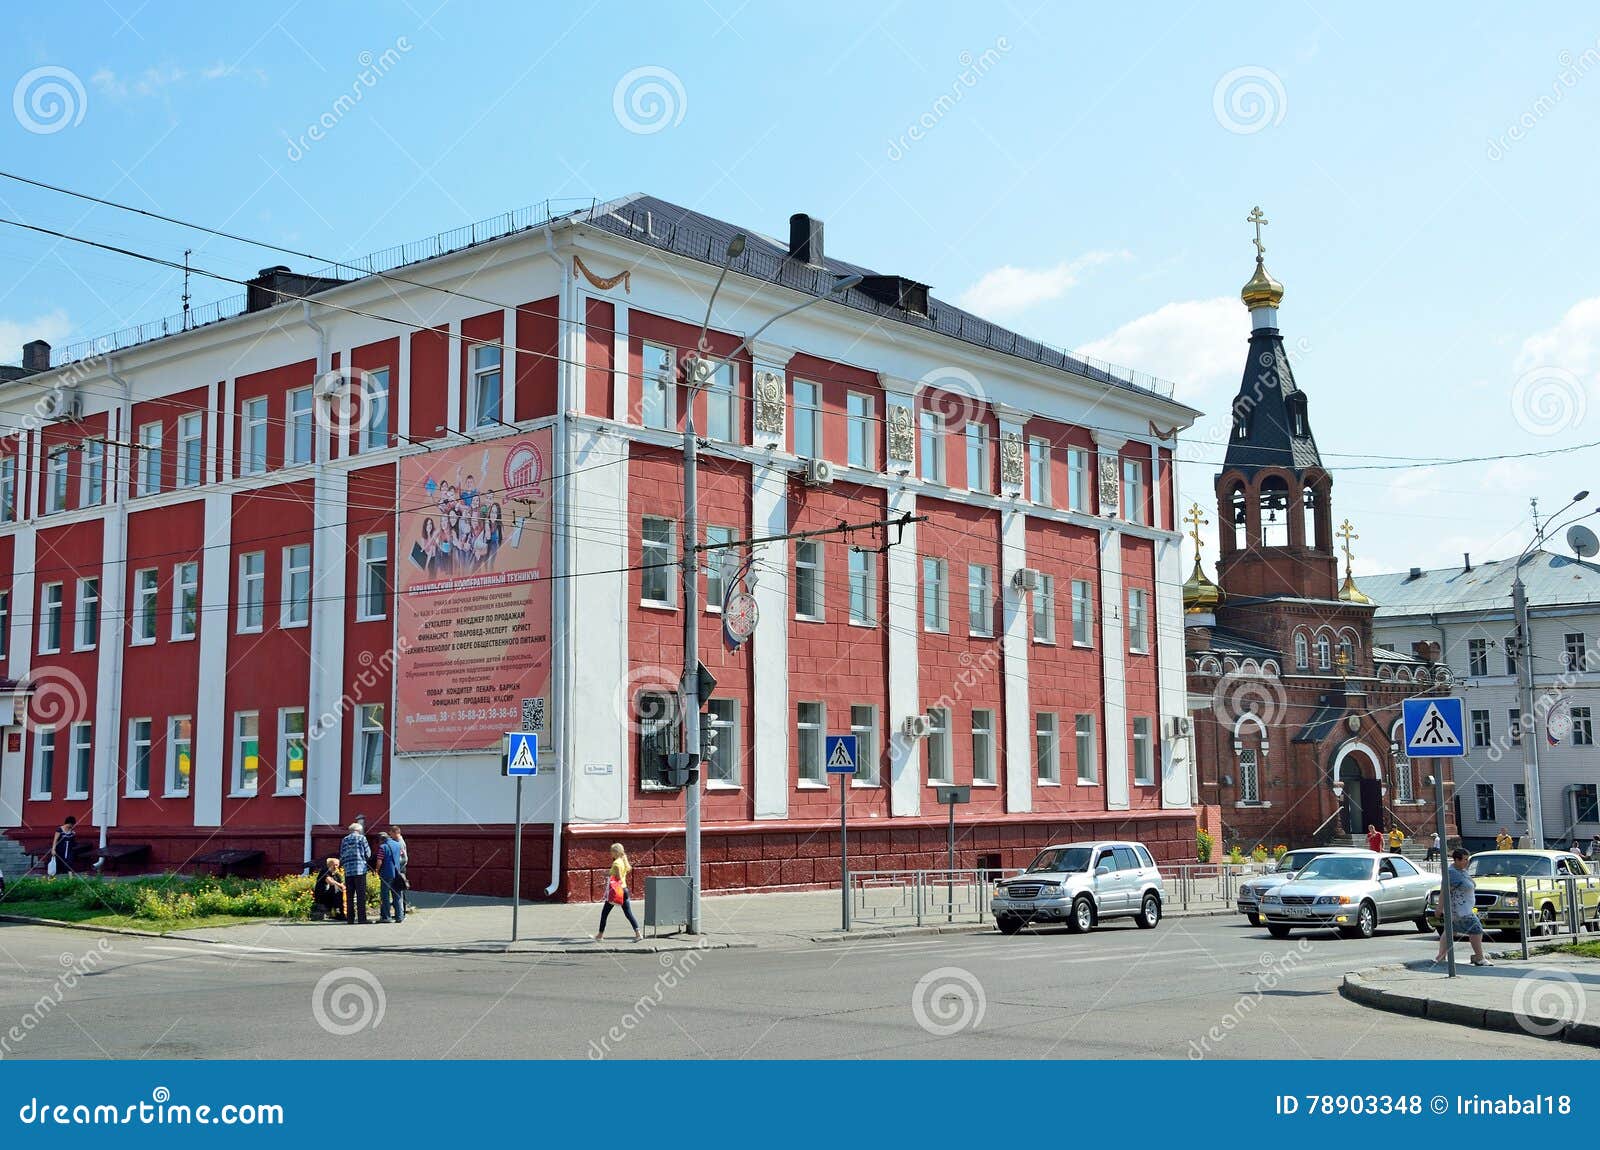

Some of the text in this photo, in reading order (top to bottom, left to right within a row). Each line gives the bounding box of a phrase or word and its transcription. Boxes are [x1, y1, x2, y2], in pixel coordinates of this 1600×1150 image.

[424, 611, 526, 629] БУХГАЛТЕР МЕНЕДЖЕР ПО ПРОДАЖАМ
[453, 625, 508, 638] ТОВАРОВЕД-ЭКСПЕРТ
[512, 623, 531, 632] ЮРИСТ
[456, 641, 473, 650] СФЕРЕ
[473, 637, 519, 648] ОБЩЕСТВЕННОГО
[519, 634, 546, 644] ПИТАНИЯ
[426, 688, 443, 696] ПОВАР
[446, 686, 473, 695] КОНДИТЕР
[475, 684, 496, 692] ПЕКАРЬ
[432, 697, 460, 706] ОФИЦИАНТ
[463, 695, 491, 705] ПРОДАВЕЦ
